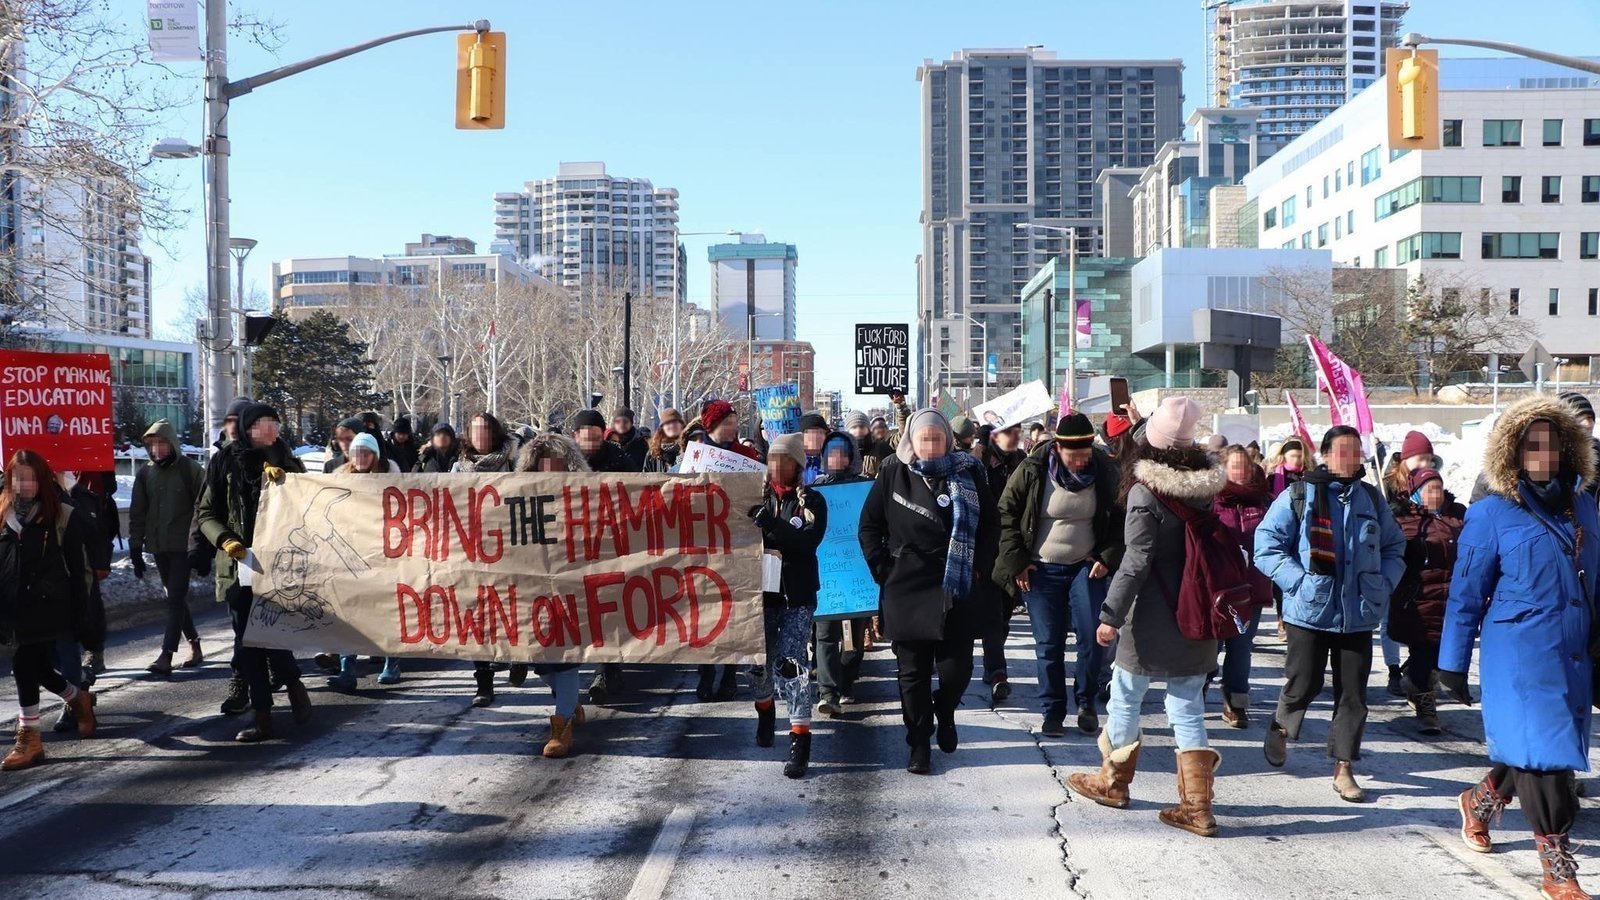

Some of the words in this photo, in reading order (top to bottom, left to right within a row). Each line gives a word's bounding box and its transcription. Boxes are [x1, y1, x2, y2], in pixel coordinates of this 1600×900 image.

[857, 327, 882, 344] FUCK
[863, 346, 889, 366] FUND
[887, 346, 907, 366] THE
[1, 365, 48, 384] STOP
[54, 366, 111, 386] MAKING
[857, 367, 907, 387] FUTURE
[4, 387, 104, 407] EDUCATION
[756, 388, 771, 397] THE
[775, 384, 795, 396] TIME
[760, 399, 767, 408] IS
[761, 408, 788, 420] RIGHT
[790, 407, 802, 418] TO
[764, 420, 773, 430] DO
[775, 420, 794, 430] THE
[382, 484, 504, 564] BRING
[504, 495, 558, 546] THE
[562, 481, 732, 563] HAMMER
[396, 582, 519, 647] DOWN
[532, 593, 582, 648] ON
[583, 565, 733, 648] FORD
